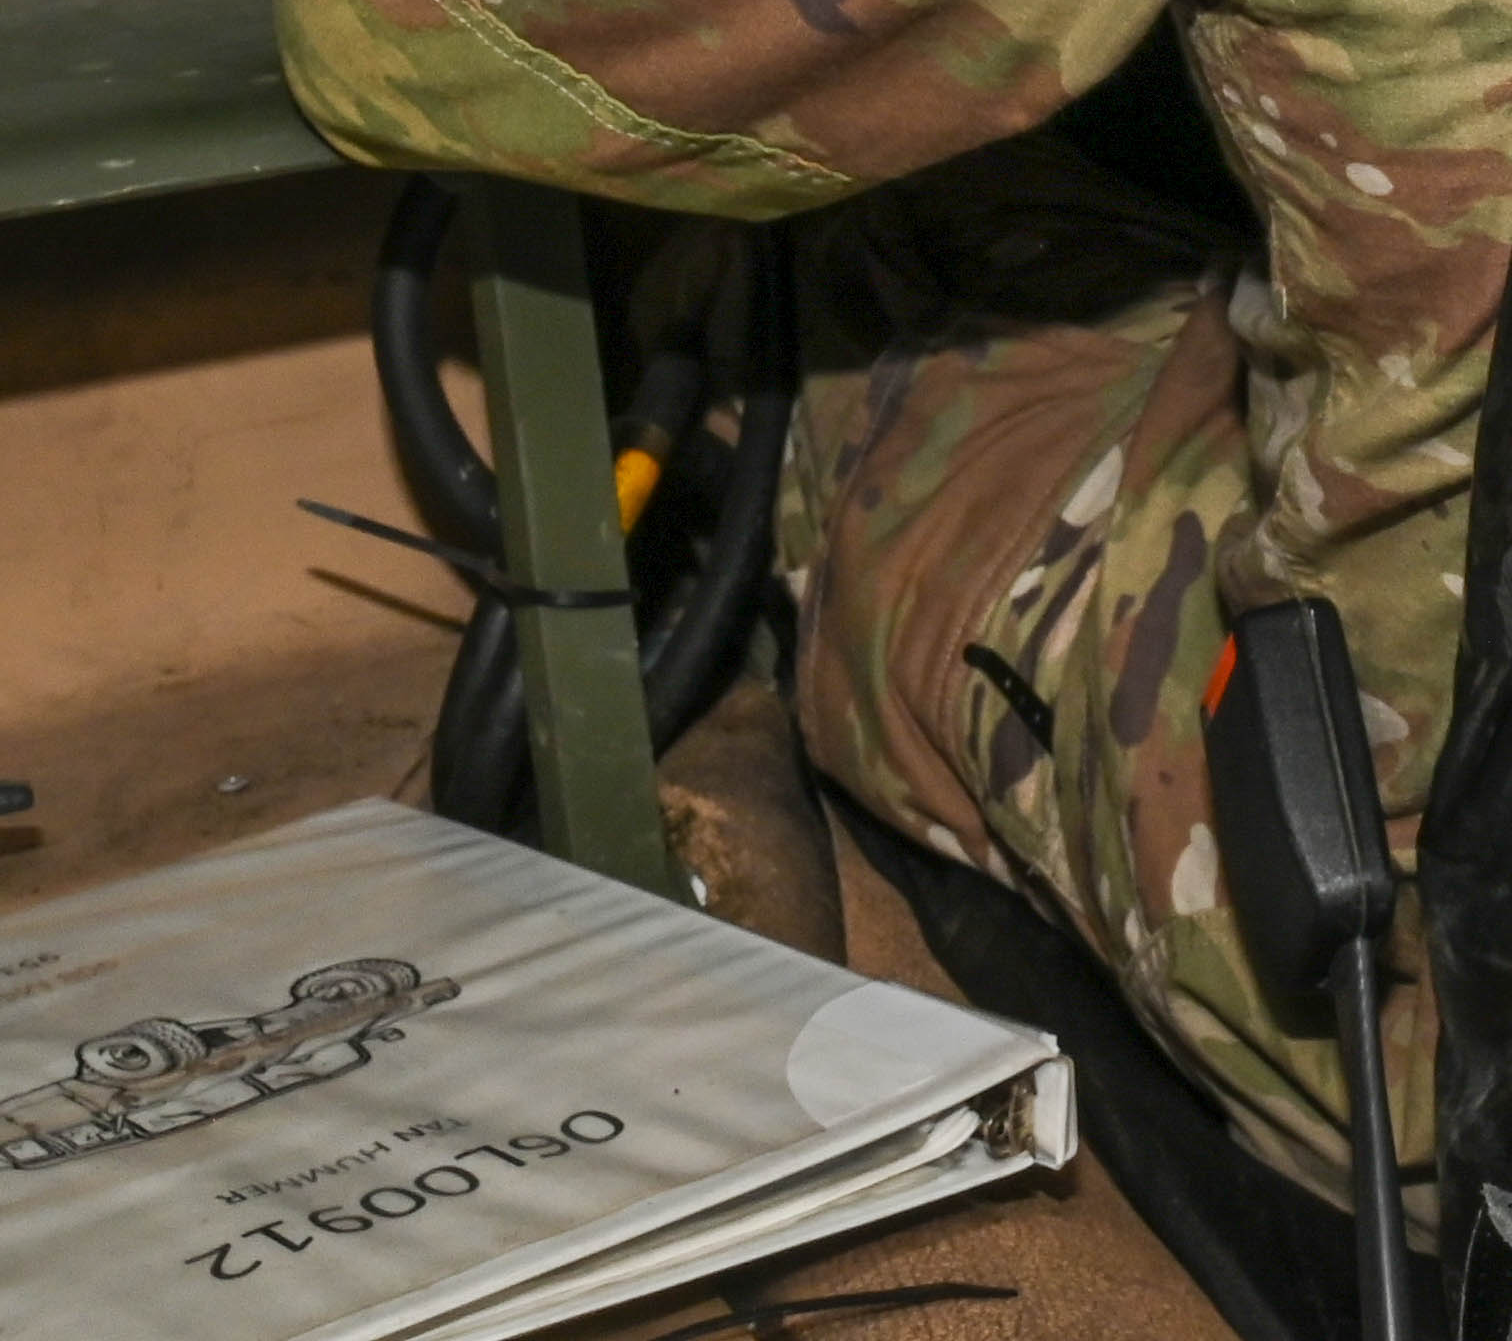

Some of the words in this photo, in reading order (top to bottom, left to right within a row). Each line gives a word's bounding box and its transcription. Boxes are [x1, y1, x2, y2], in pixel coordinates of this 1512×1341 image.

[391, 1116, 472, 1145] TAN
[184, 1108, 627, 1282] 06L00912
[215, 1131, 391, 1205] HUMMER
